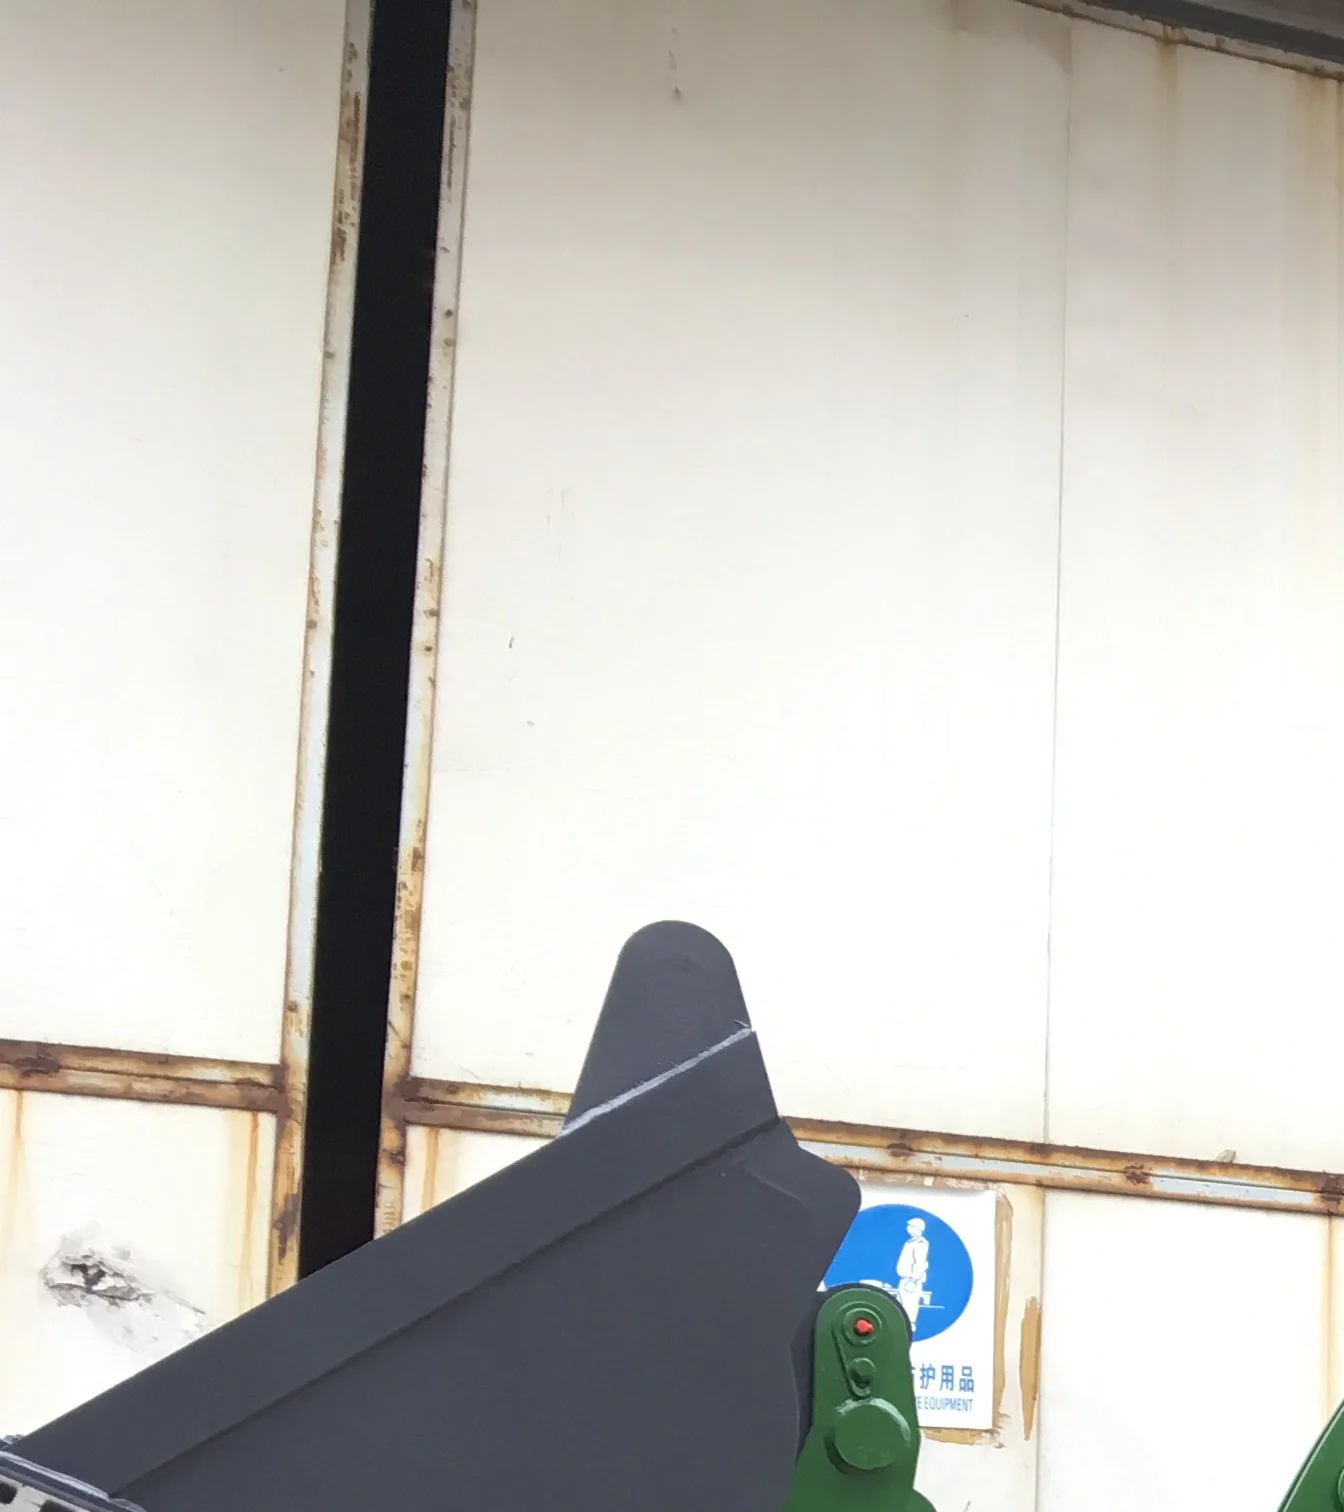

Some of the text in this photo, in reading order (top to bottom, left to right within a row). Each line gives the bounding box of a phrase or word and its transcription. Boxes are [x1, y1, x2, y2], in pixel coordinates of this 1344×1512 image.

[911, 1363, 975, 1393] 护用品
[924, 1396, 973, 1412] EQUIPMENT
